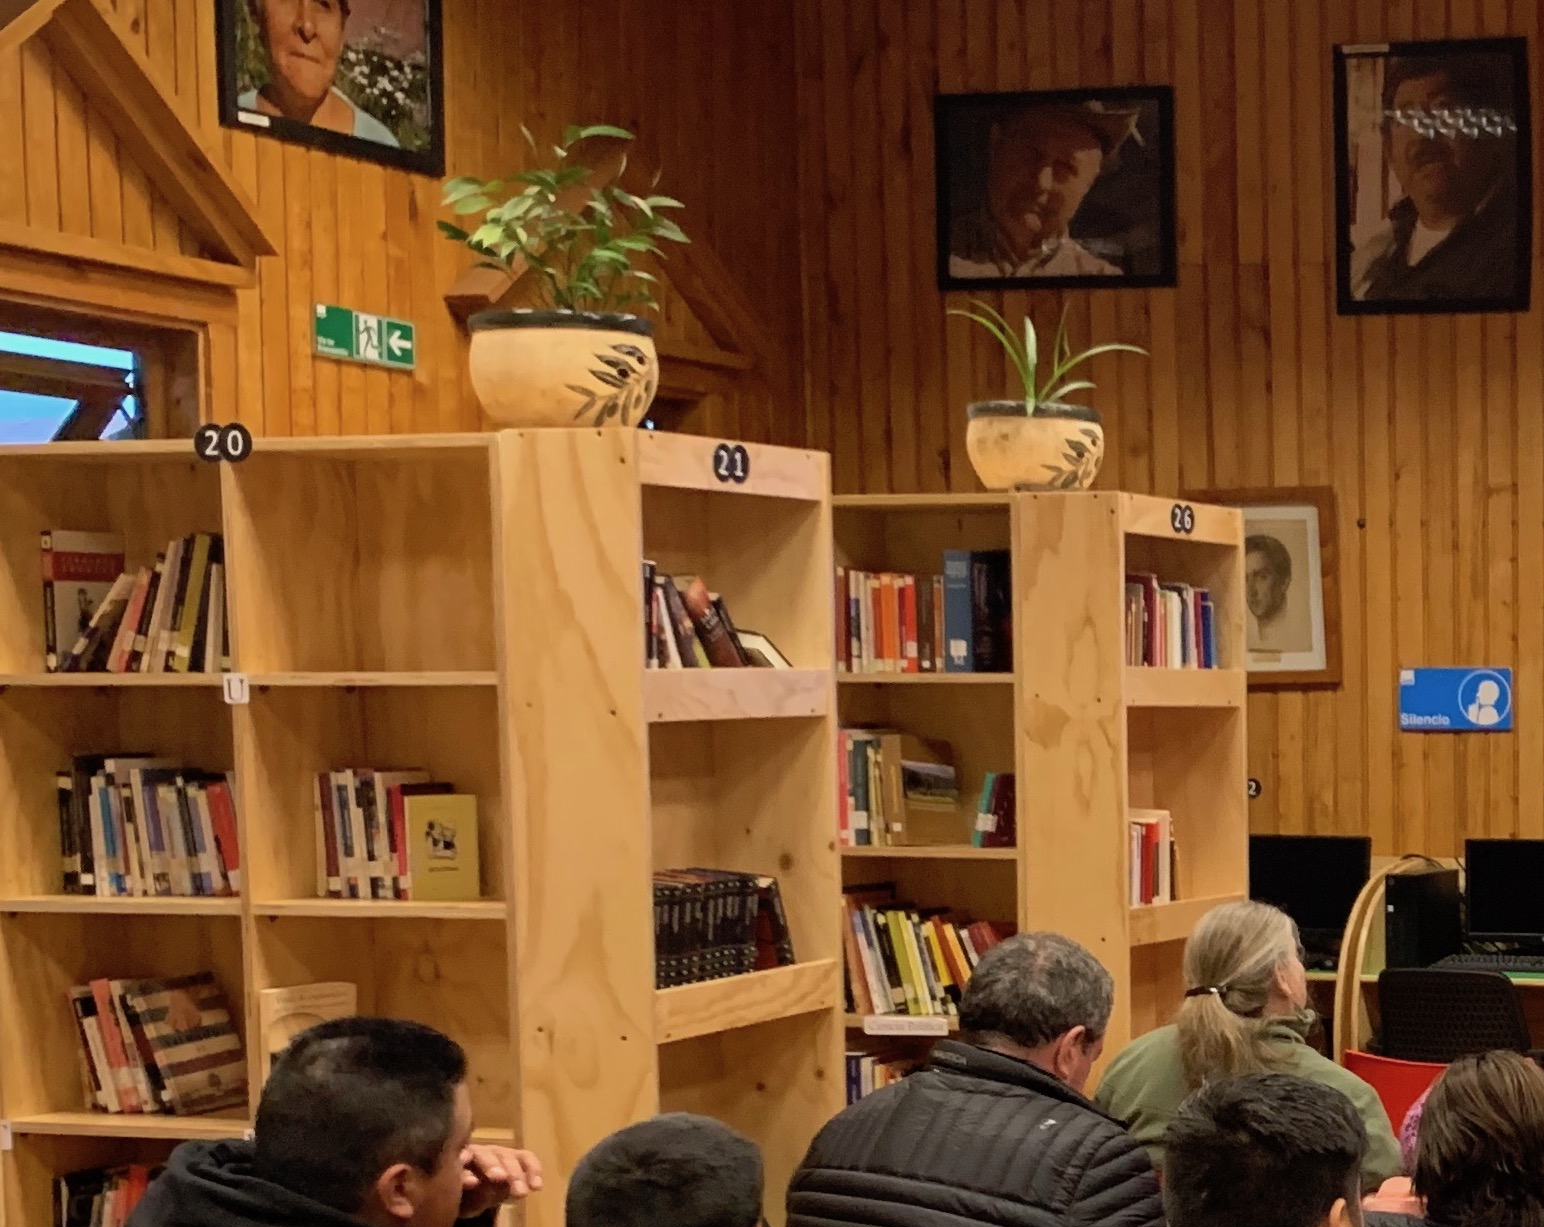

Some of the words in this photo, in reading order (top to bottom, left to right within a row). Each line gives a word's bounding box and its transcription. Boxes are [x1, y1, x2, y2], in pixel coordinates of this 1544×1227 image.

[204, 429, 244, 456] 20
[719, 449, 744, 477] 21
[1174, 507, 1192, 530] 26
[226, 678, 245, 701] U
[1400, 712, 1450, 726] Silencio
[1248, 781, 1257, 796] 2
